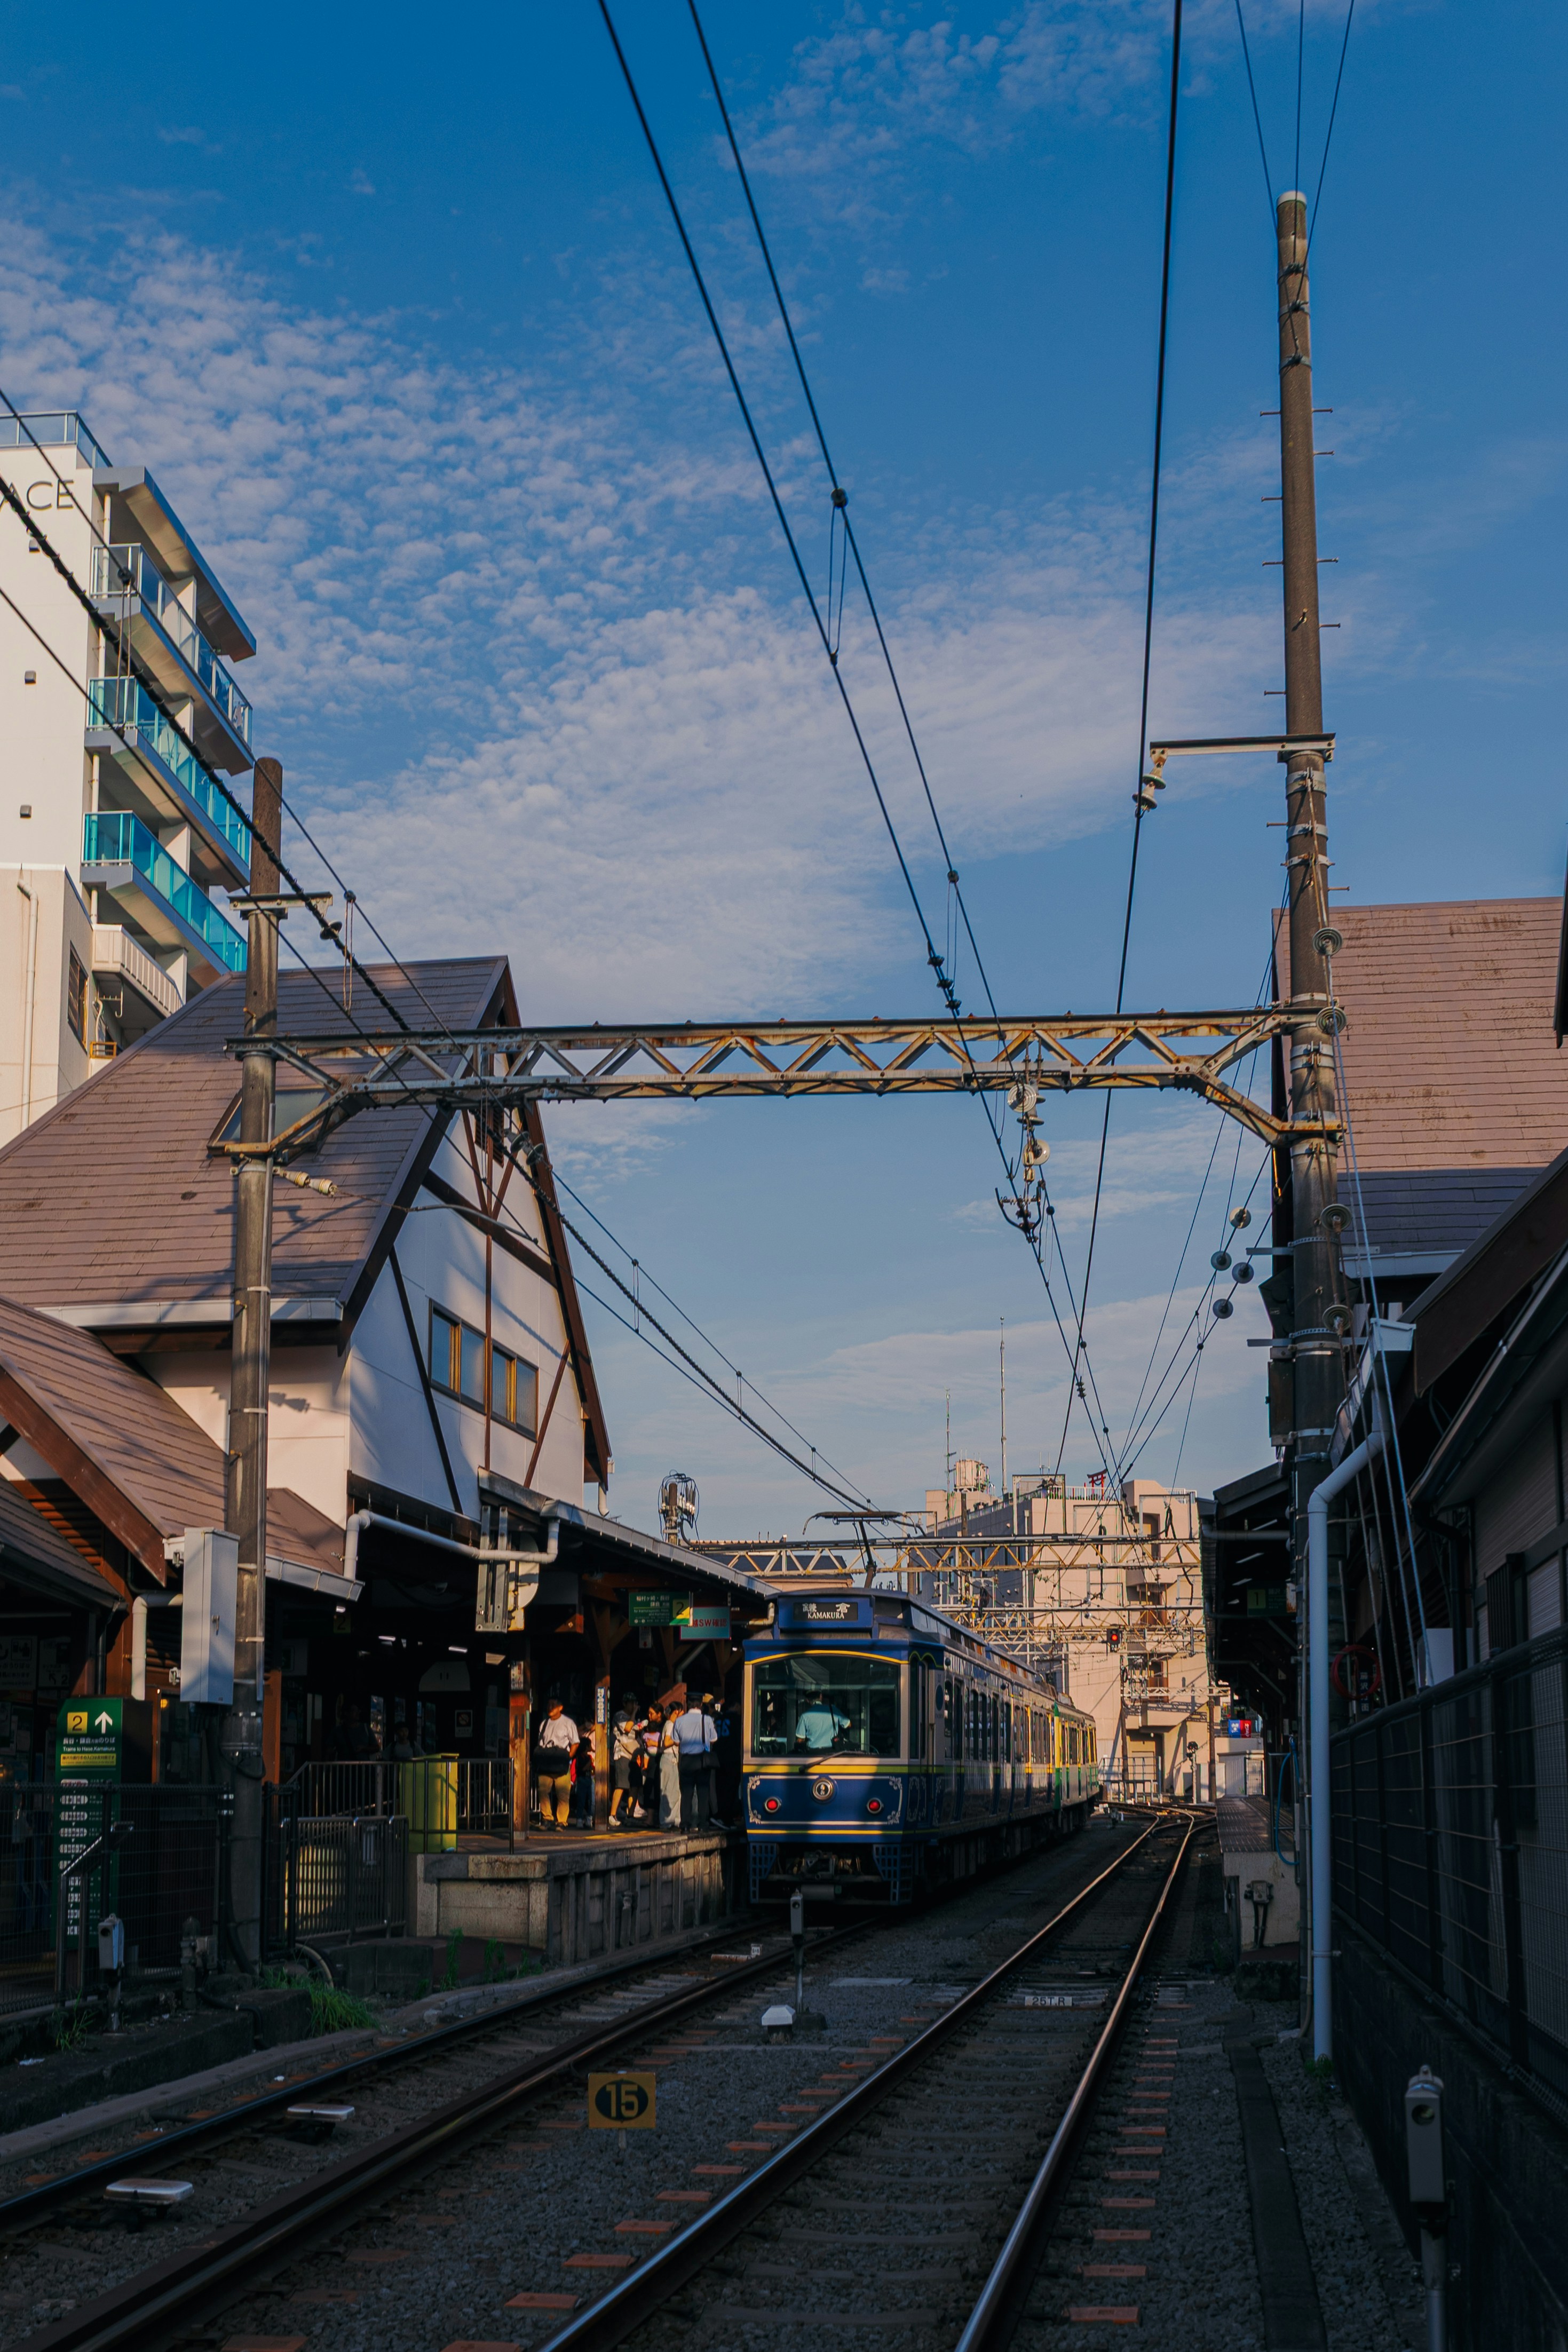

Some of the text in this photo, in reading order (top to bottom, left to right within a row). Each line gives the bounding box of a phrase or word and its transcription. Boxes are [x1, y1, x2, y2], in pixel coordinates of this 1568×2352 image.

[1254, 1592, 1258, 1606] 1
[676, 1602, 687, 1615] 2
[807, 1611, 844, 1619] KAMAKURA
[337, 1615, 346, 1630] 2
[72, 1715, 82, 1731] 2
[606, 2084, 639, 2118] 15
